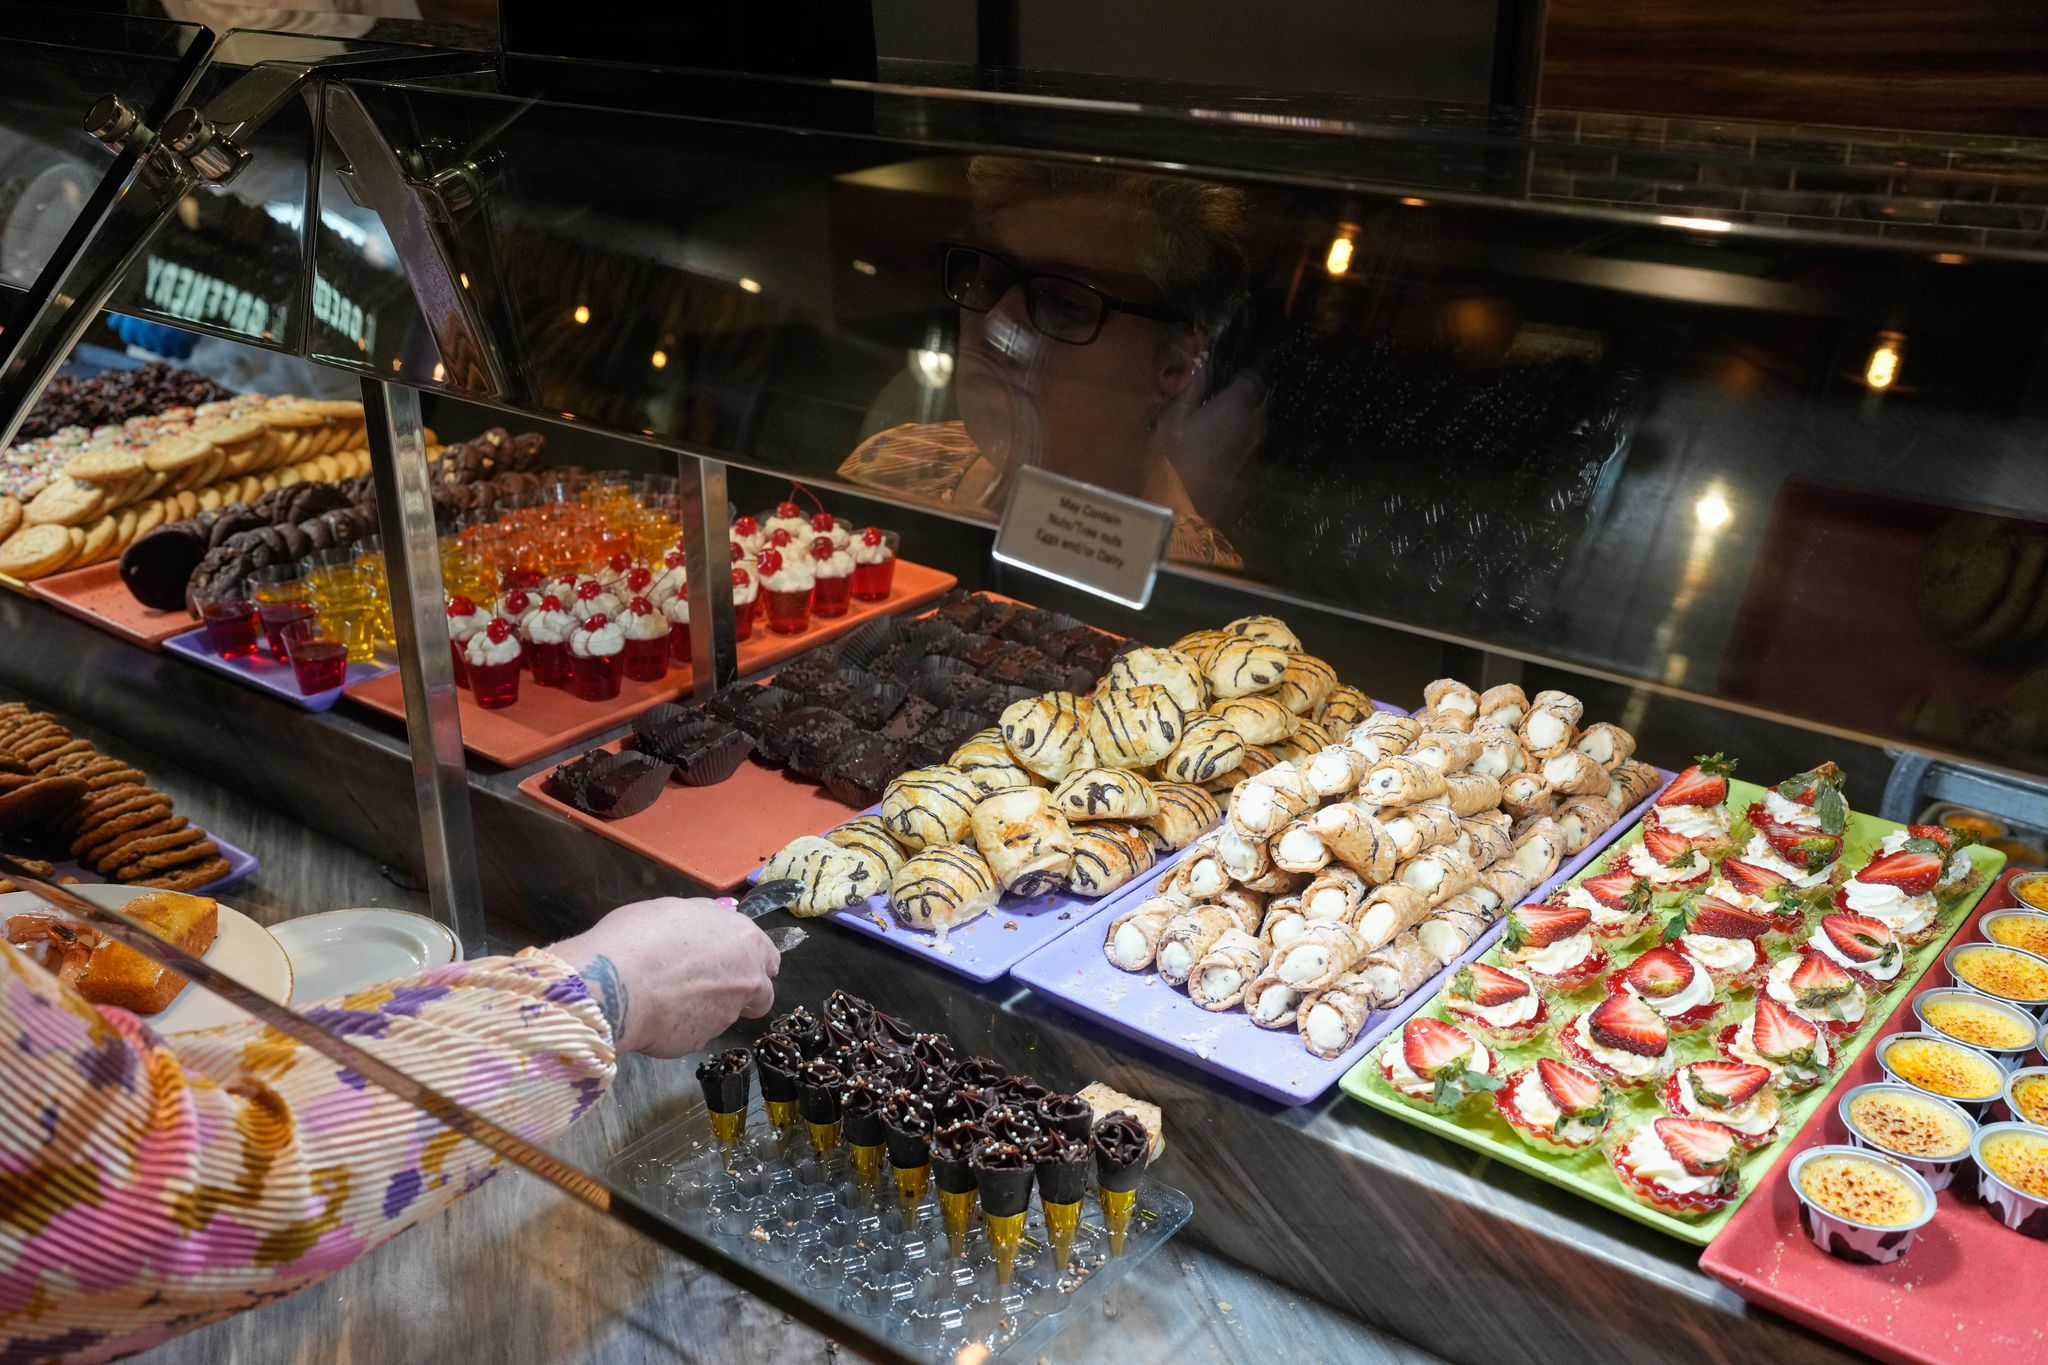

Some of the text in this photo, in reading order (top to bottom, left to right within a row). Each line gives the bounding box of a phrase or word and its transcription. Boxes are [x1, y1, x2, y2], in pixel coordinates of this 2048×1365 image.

[1060, 497, 1122, 525] May Contain
[1101, 533, 1123, 547] nuts
[1062, 540, 1095, 557] and/or
[1097, 549, 1124, 569] Dairy
